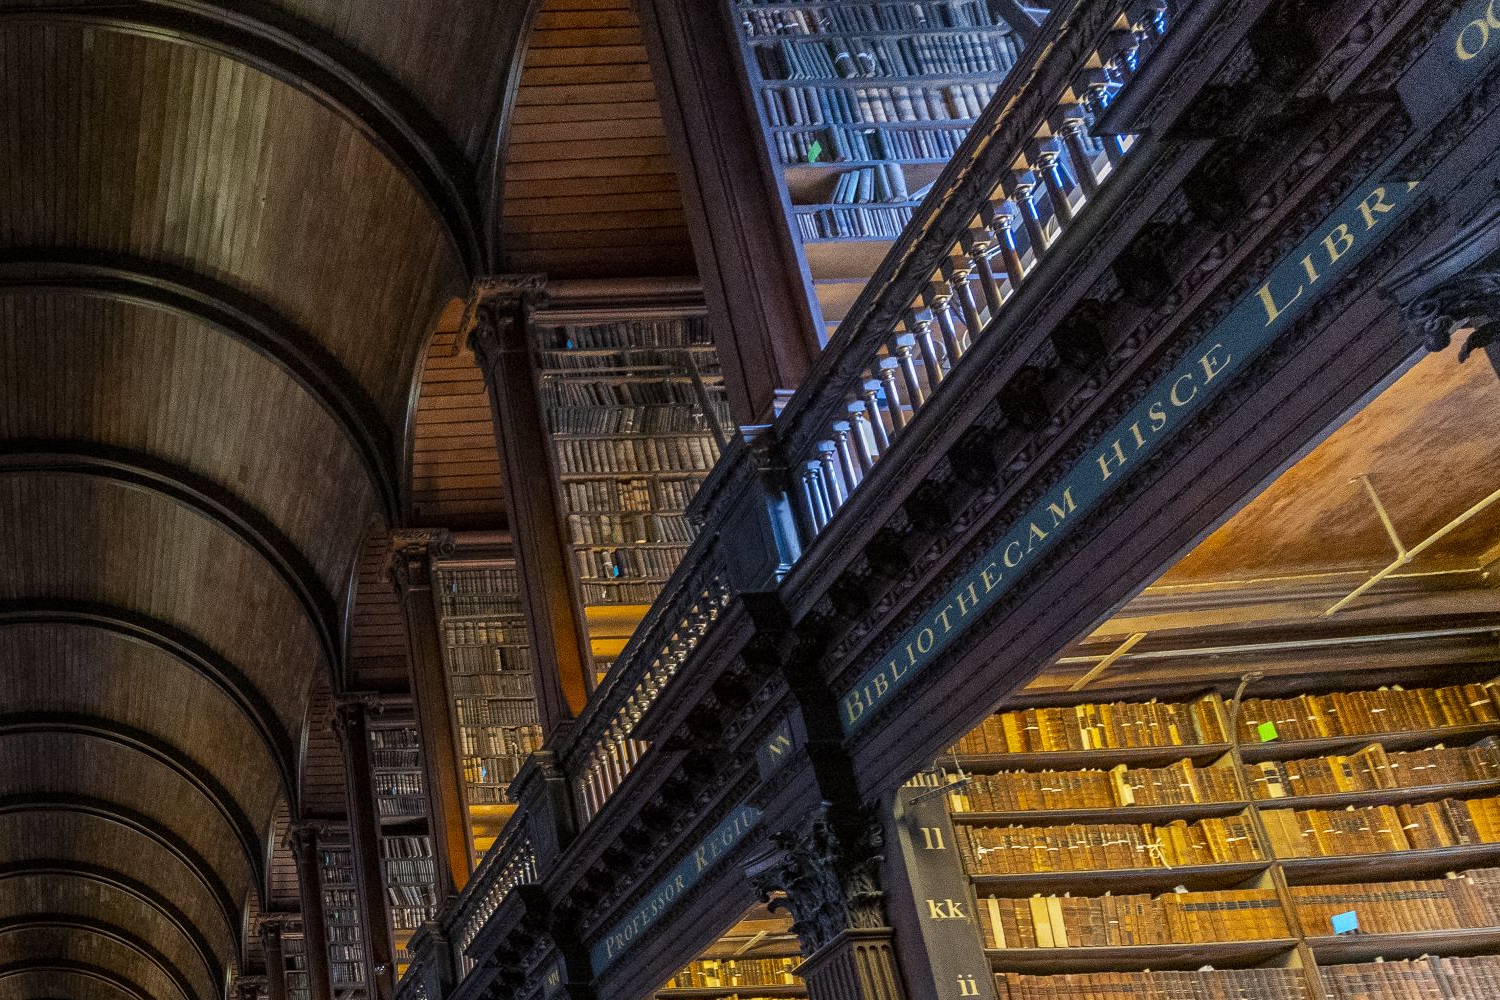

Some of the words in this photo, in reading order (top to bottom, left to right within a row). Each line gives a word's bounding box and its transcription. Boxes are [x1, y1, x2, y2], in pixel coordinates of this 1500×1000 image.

[844, 487, 1080, 729] BIBLIOTHECAM
[1097, 342, 1232, 482] HISCE
[1256, 181, 1420, 328] LIBR
[920, 827, 945, 850] ll
[605, 874, 686, 960] PROFESSOR
[926, 899, 966, 919] kk
[957, 974, 980, 997] ii
